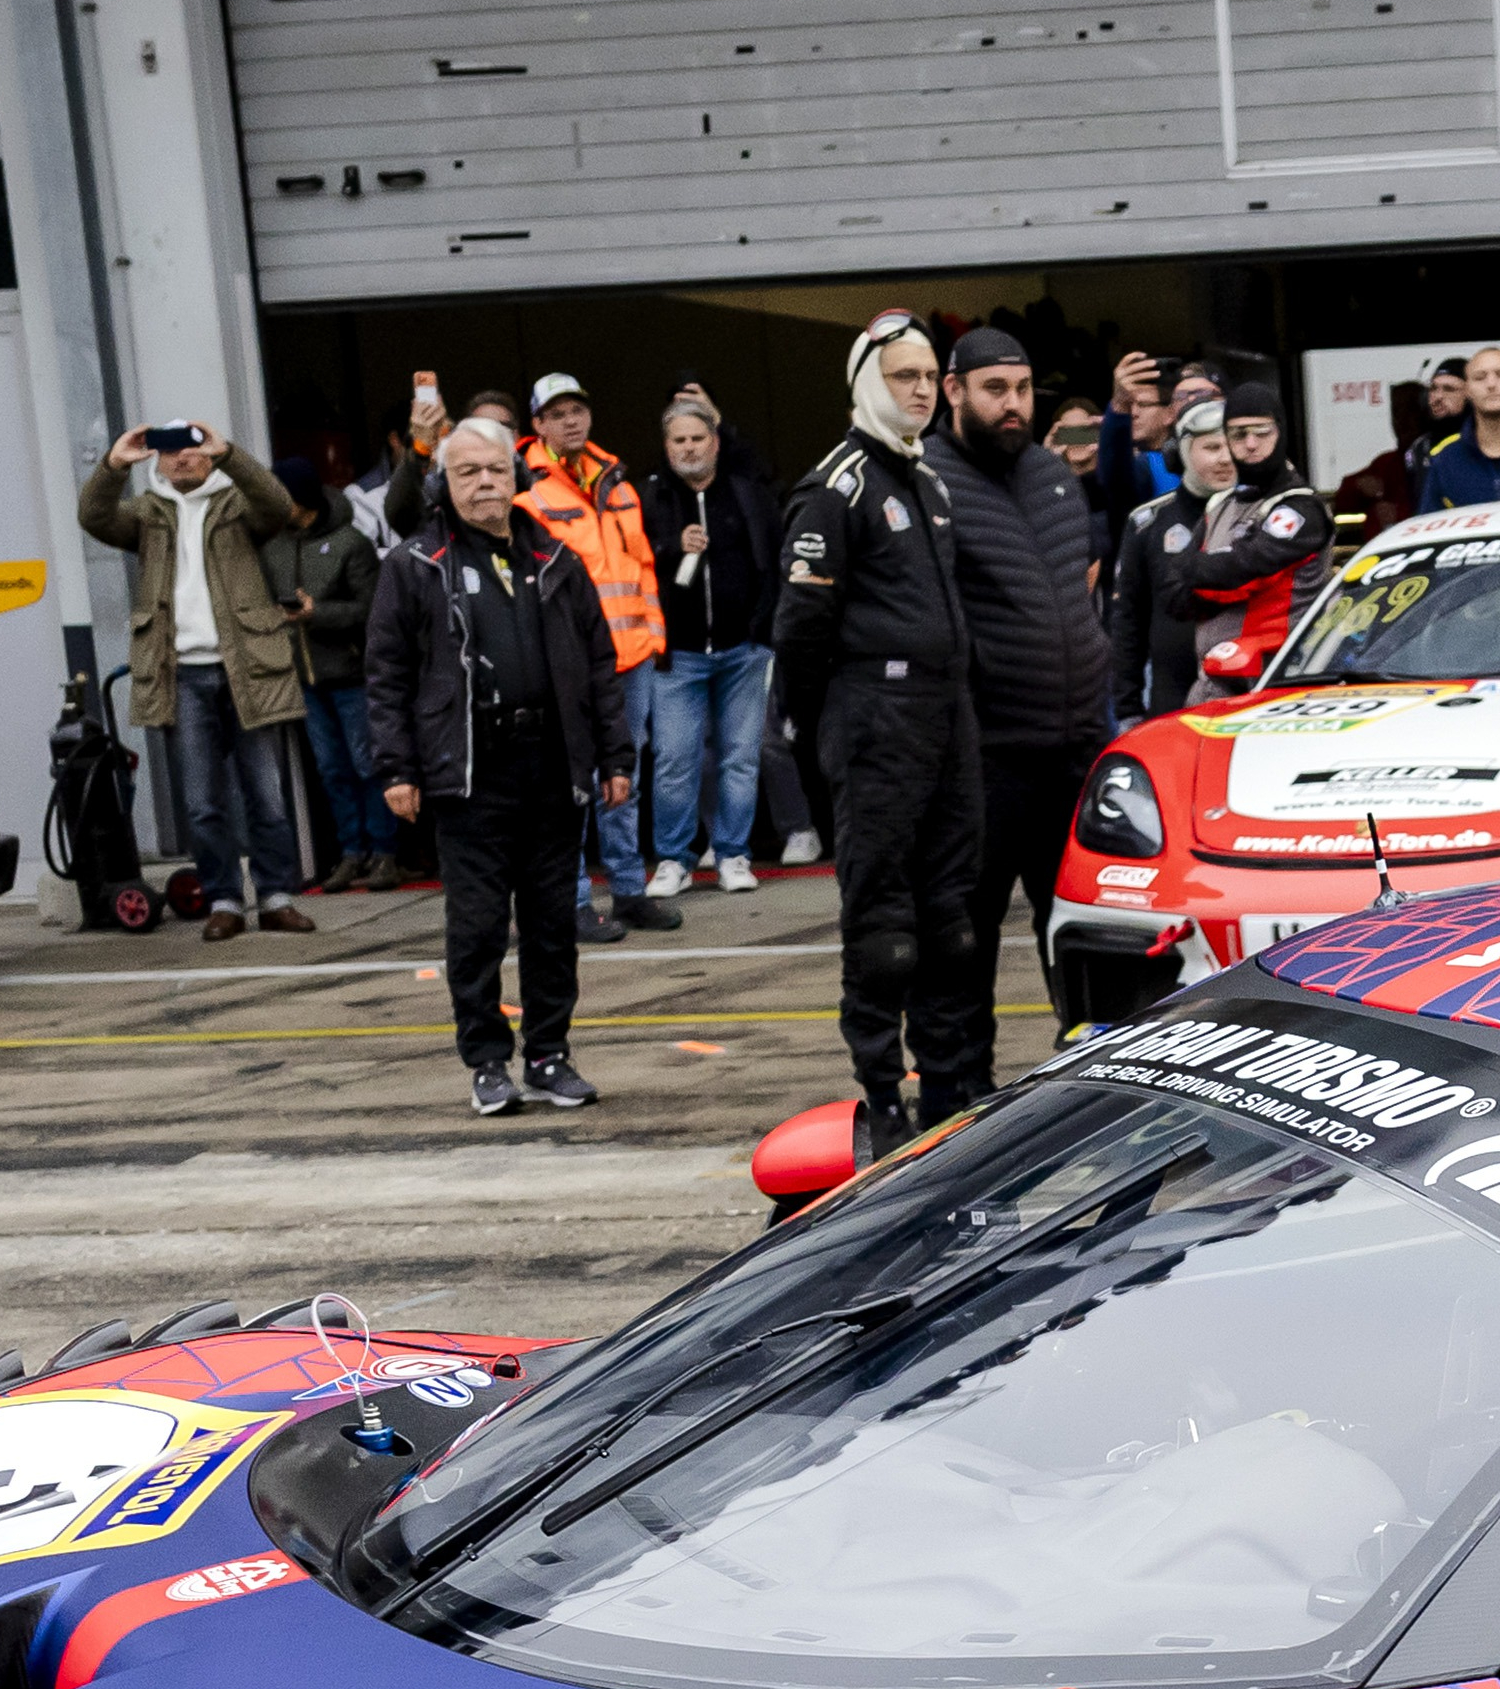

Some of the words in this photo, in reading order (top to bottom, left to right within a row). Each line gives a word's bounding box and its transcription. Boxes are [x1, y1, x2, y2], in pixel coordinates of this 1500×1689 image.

[1403, 512, 1492, 538] sorg
[1110, 1020, 1260, 1073] GRAN
[1077, 1063, 1115, 1081] THE
[1114, 1066, 1165, 1088] REAL
[1159, 1072, 1242, 1106] DRIVING
[1235, 1092, 1377, 1153] SIMULATOR
[110, 1425, 248, 1528] RAVENOL
